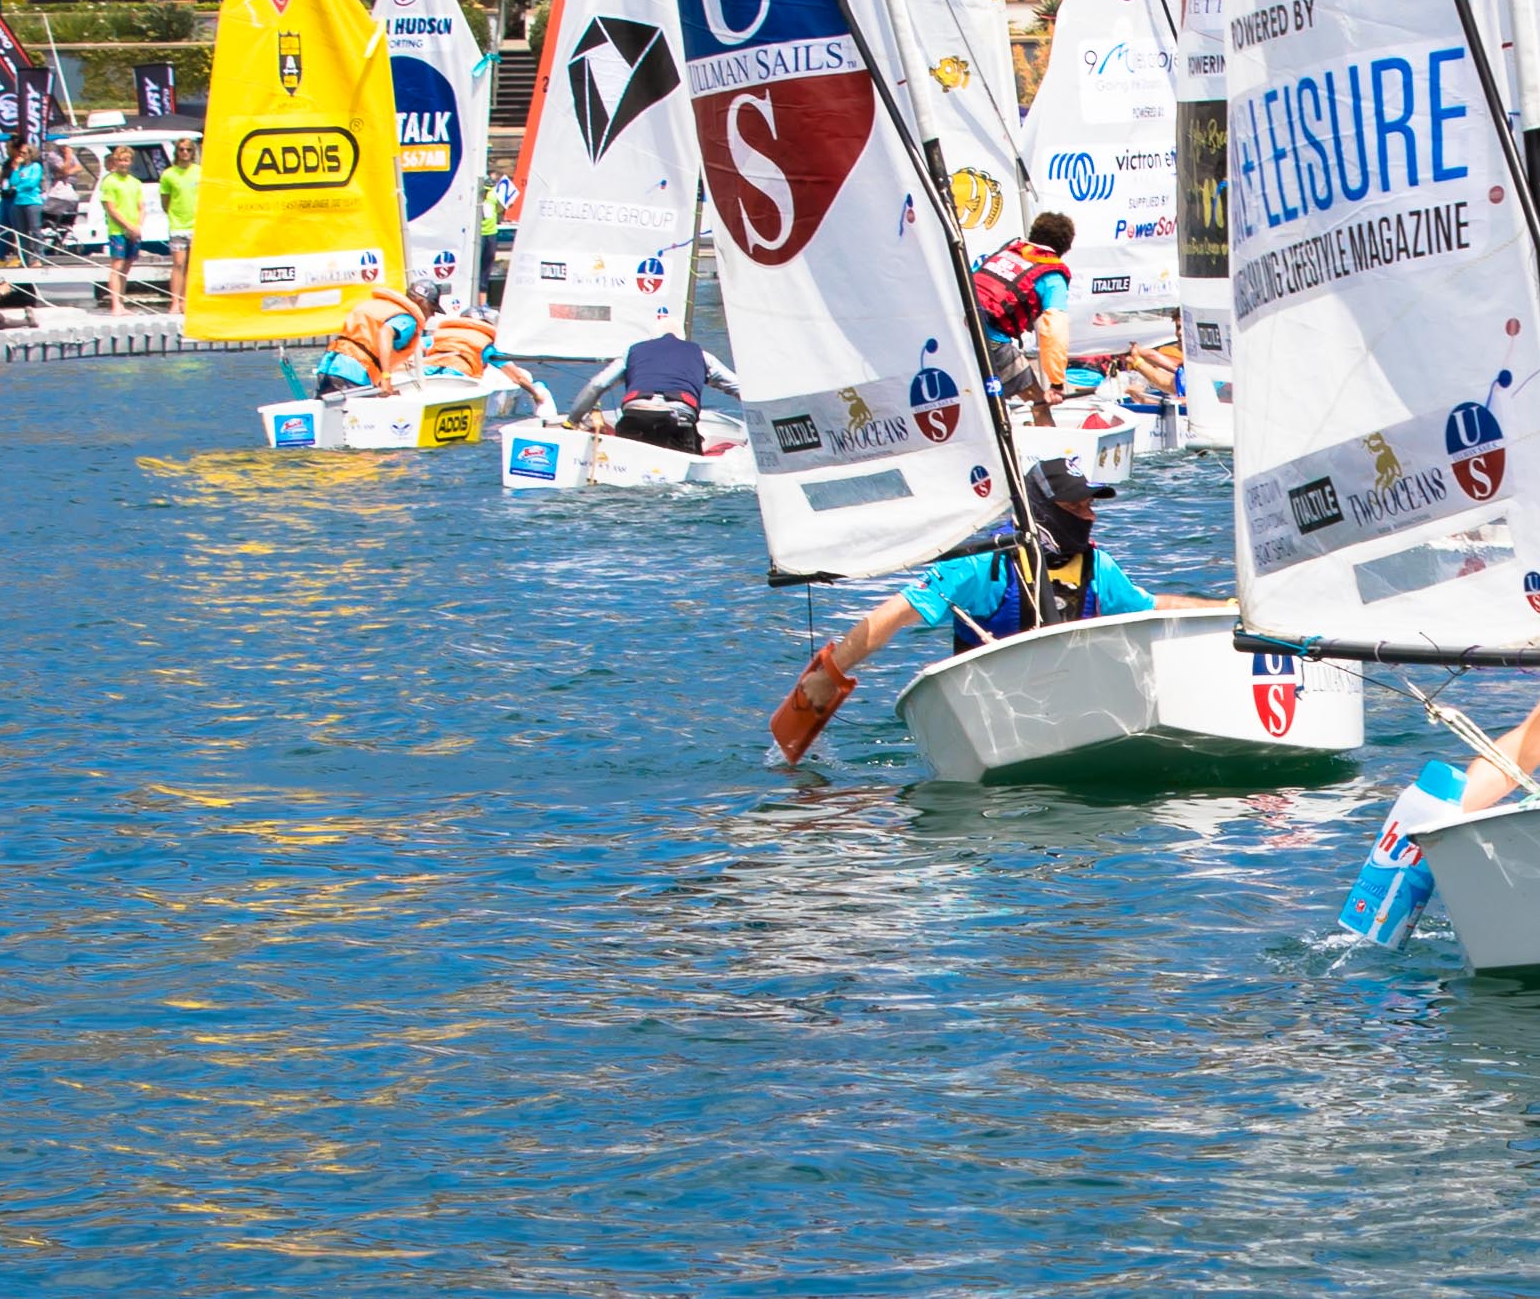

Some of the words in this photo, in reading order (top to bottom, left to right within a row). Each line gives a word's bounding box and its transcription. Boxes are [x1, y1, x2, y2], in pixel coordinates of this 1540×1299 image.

[688, 55, 749, 94] ULLMAN
[756, 43, 843, 80] SAILS
[398, 112, 452, 143] TALK
[726, 89, 794, 253] S
[1116, 149, 1161, 170] victron
[617, 206, 675, 227] GROUP
[1348, 202, 1470, 272] MAGAZINE
[1093, 277, 1130, 292] ITALTILE
[919, 371, 939, 401] U
[437, 414, 468, 434] ADDIS
[775, 420, 819, 448] ITALTILE
[826, 428, 854, 455] TWO
[854, 417, 908, 448] OCEANS
[928, 409, 946, 440] S
[1453, 406, 1481, 446] U
[1469, 457, 1492, 499] S
[1293, 484, 1340, 526] ITALTILE
[1347, 490, 1383, 527] TWO
[1380, 468, 1447, 517] OCEANS
[1268, 685, 1286, 734] S
